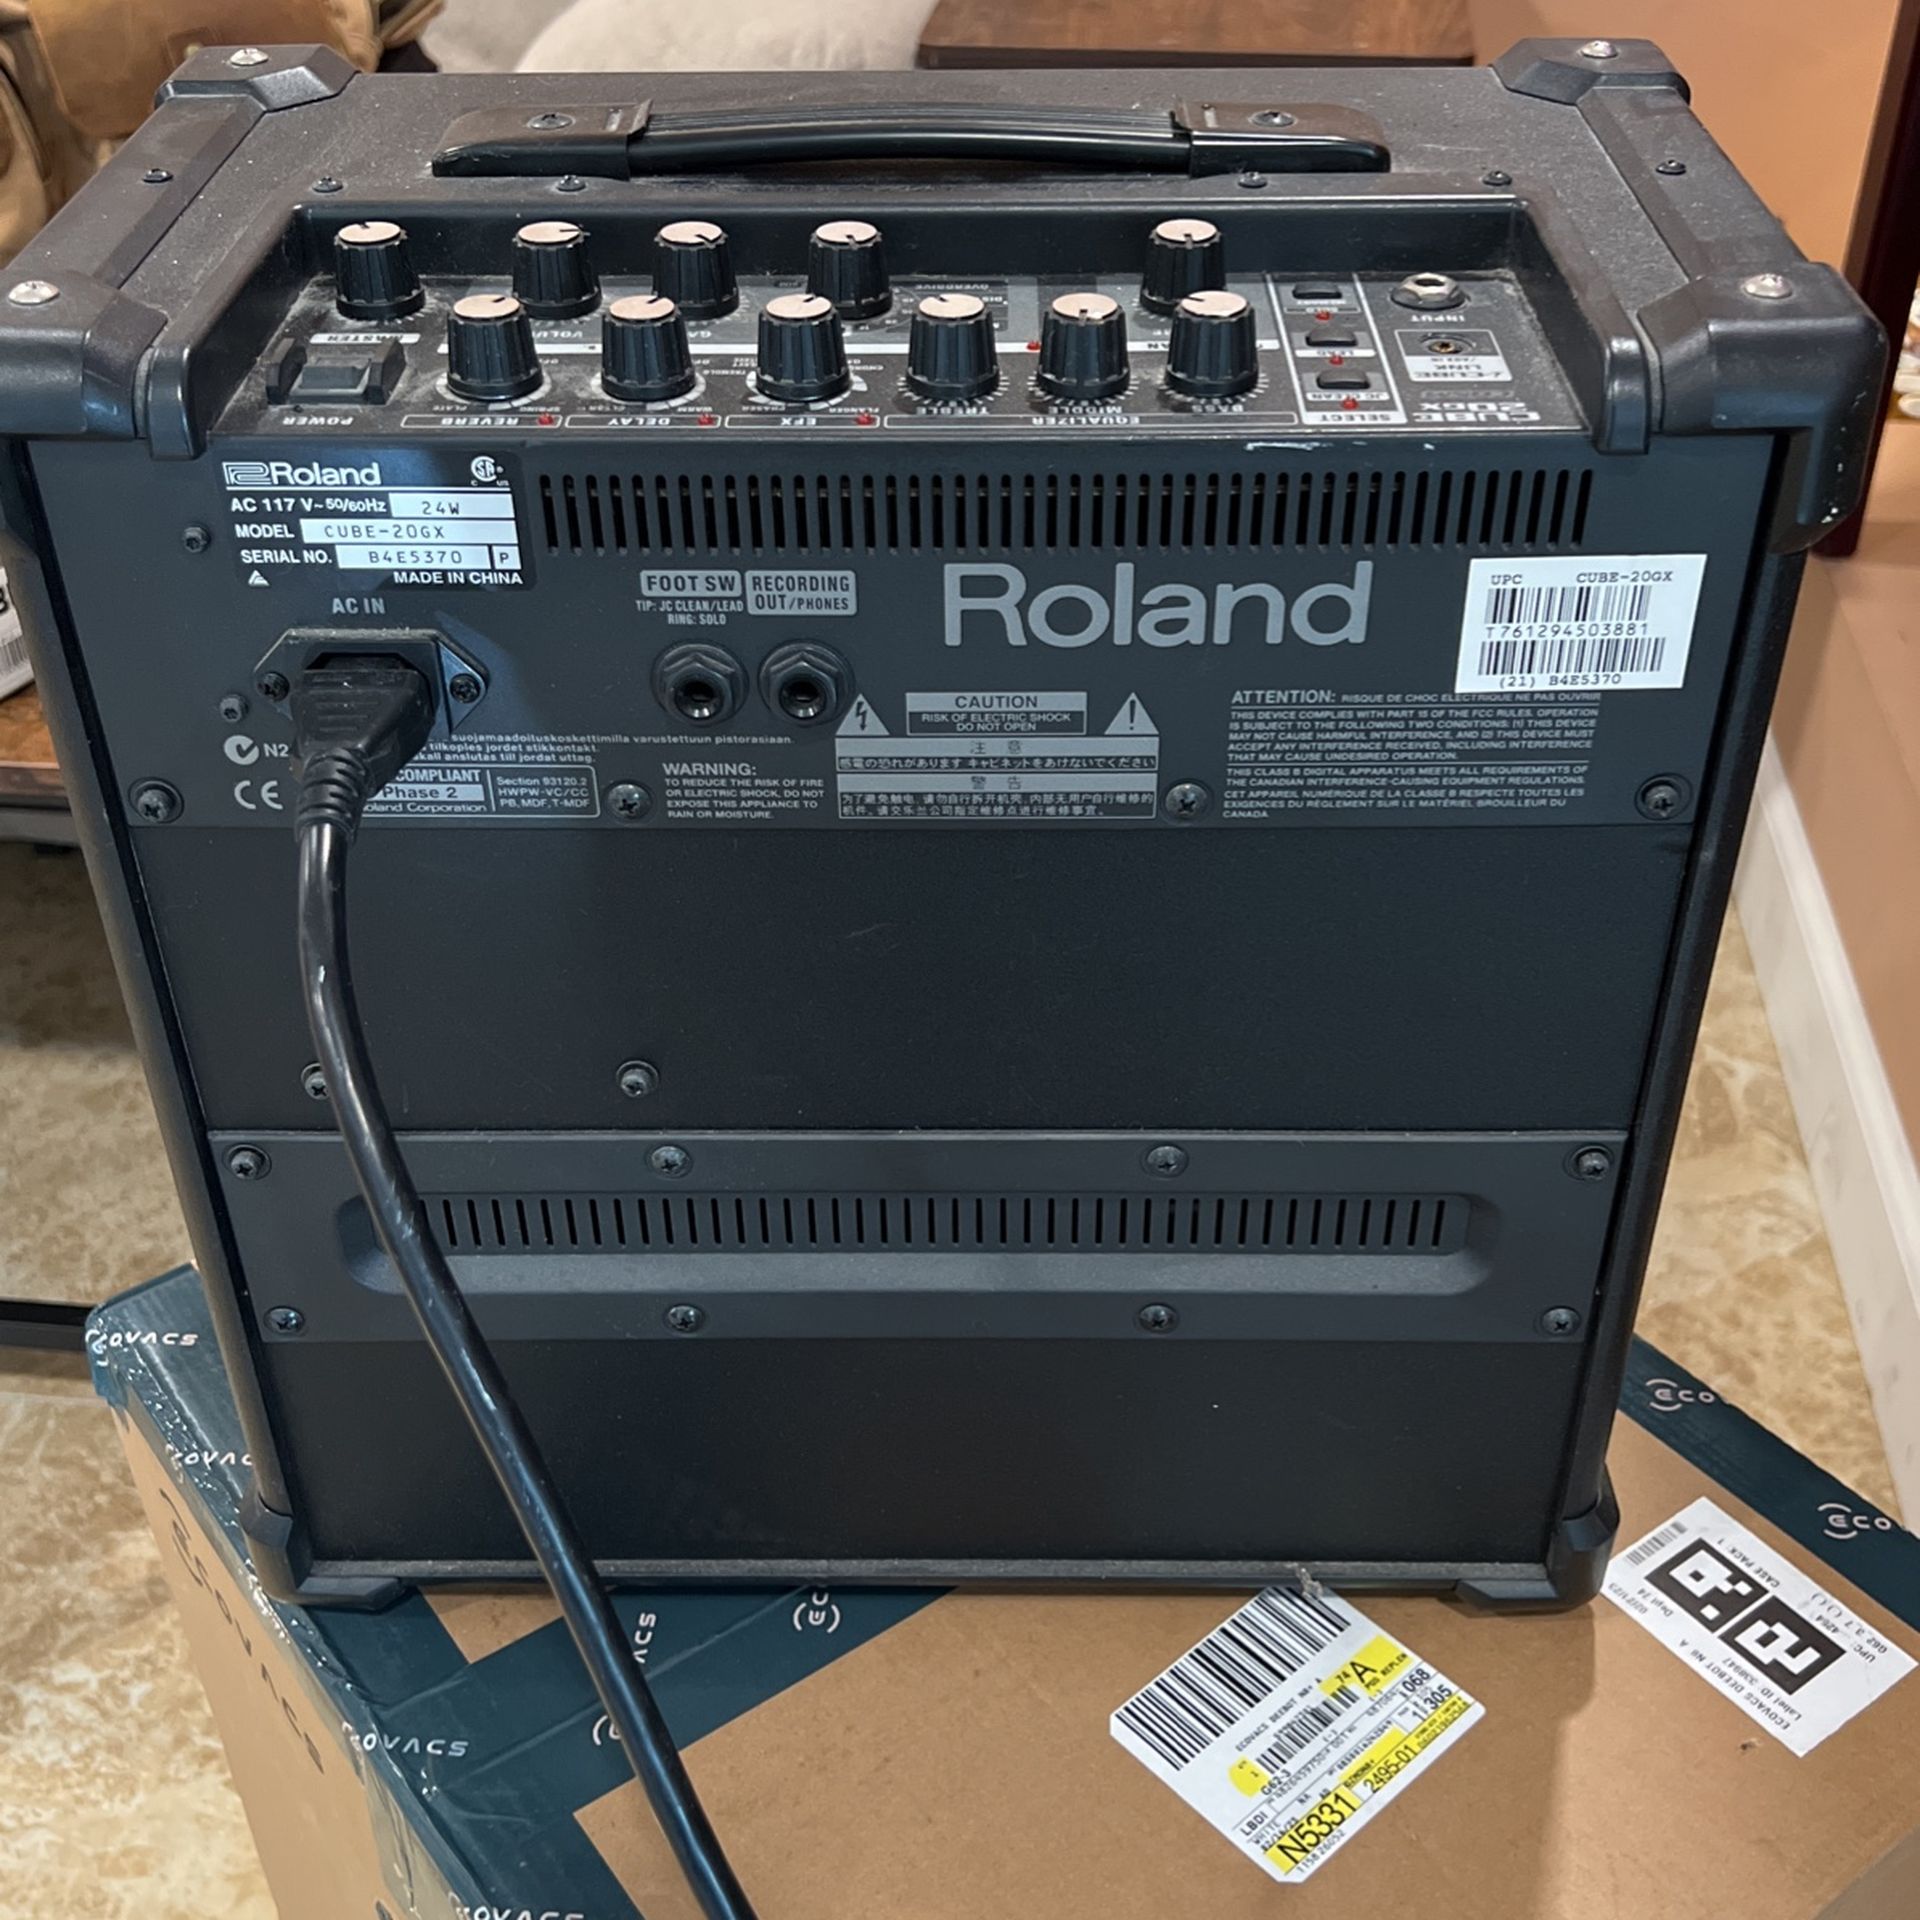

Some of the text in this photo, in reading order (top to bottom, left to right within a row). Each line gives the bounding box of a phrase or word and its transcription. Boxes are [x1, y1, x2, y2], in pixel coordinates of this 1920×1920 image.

[1048, 406, 1122, 414] MIDDLE
[1192, 404, 1244, 412] BASS
[282, 416, 354, 426] POWER
[441, 417, 518, 426] REVERB
[608, 417, 671, 426] DELAY
[780, 418, 816, 426] EFX
[1032, 416, 1140, 425] EQUALIZER
[1320, 414, 1392, 422] SELECT
[1413, 412, 1541, 422] CUBE
[269, 462, 382, 486] Roland
[231, 498, 257, 512] AC
[262, 498, 295, 512] 117
[422, 500, 460, 514] 24W
[234, 524, 295, 538] MODEL
[324, 524, 444, 538] CUBE-20GX
[241, 550, 332, 564] SERIAL NO.
[368, 551, 462, 564] B4E5370
[500, 552, 508, 564] P
[393, 571, 523, 584] MADE IN CHINA
[646, 575, 736, 592] FOOT SW
[752, 575, 850, 592] RECORDING
[1490, 570, 1674, 586] UPC CUBE-20GX
[332, 598, 386, 614] AC IN
[636, 600, 744, 612] TIP: JC CLEAN/LEAD
[754, 594, 849, 610] OUT/PHONES
[942, 561, 1374, 648] Roland
[668, 614, 726, 625] RING: SOLO
[1499, 674, 1622, 688] (21) B4E5370
[954, 696, 1038, 709] CAUTION
[1232, 690, 1336, 704] ATTENTION:
[921, 712, 1070, 723] RISK OF ELECTRIC SHOCK
[956, 722, 1036, 732] DO NOT OPEN
[486, 743, 522, 754] jordet
[501, 753, 516, 762] till
[518, 753, 556, 762] jordat
[662, 762, 757, 776] WARNING:
[497, 777, 540, 786] Section
[664, 778, 824, 787] TO REDUCE THE RISK OF FIRE
[234, 780, 284, 810] CE
[383, 786, 458, 798] Phase 2
[666, 789, 682, 798] OR
[684, 789, 738, 798] ELECTRIC
[784, 789, 800, 798] DO
[802, 789, 824, 798] NOT
[364, 802, 487, 813] oland Corporation
[552, 798, 590, 808] T-MDF
[667, 800, 818, 808] EXPOSE THIS APPLIANCE TO
[668, 810, 694, 819] RAIN
[696, 810, 713, 819] OR
[1751, 1565, 1781, 1588] CASE
[1636, 1587, 1674, 1617] Dept 74
[1335, 1661, 1378, 1684] 74 A
[1704, 1661, 1745, 1693] DEEBOT
[1401, 1667, 1431, 1693] 068
[1423, 1684, 1453, 1710] 305
[1742, 1691, 1791, 1730] ECOVACS
[1771, 1696, 1802, 1721] Label
[1362, 1743, 1418, 1793] 2495-01
[1260, 1768, 1292, 1796] G62-3
[1239, 1811, 1269, 1835] LBDI
[1276, 1791, 1357, 1863] N5331
